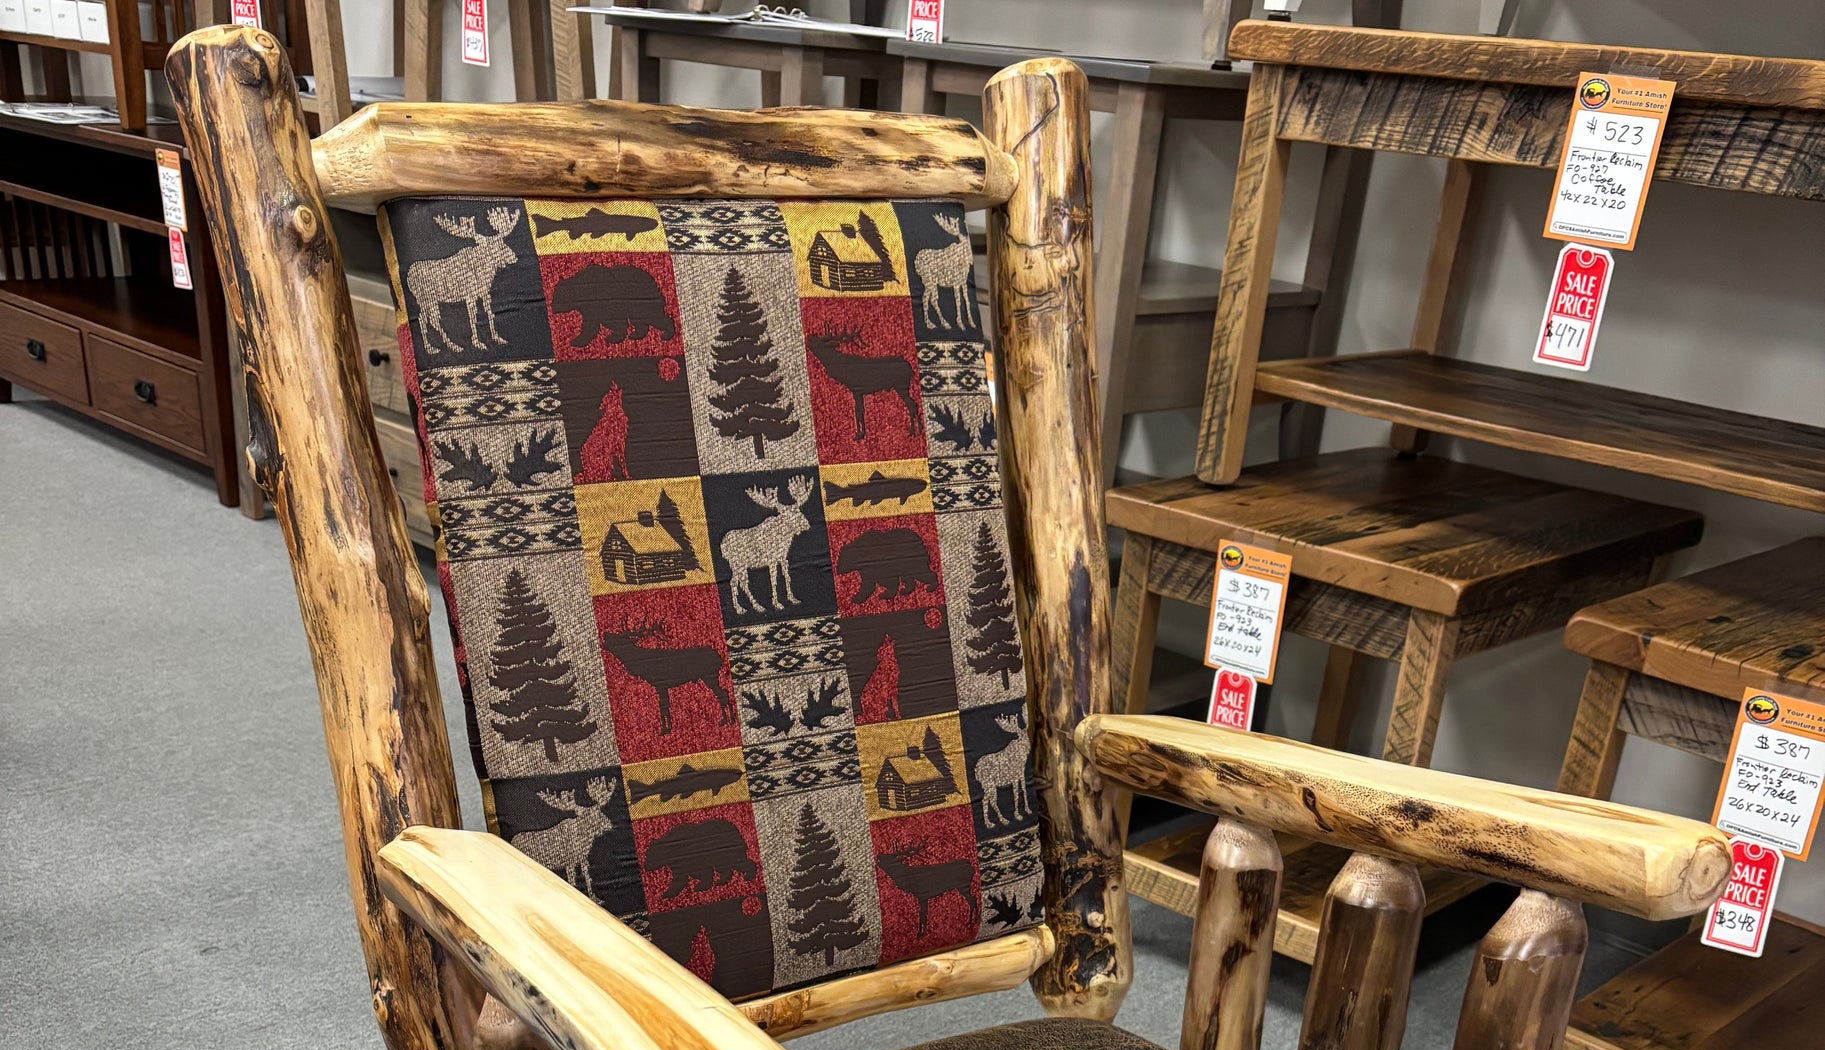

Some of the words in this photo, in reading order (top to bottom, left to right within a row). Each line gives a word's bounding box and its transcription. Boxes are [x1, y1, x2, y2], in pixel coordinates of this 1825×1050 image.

[236, 3, 255, 16] PRICE
[913, 1, 938, 18] PRICE
[1611, 98, 1644, 107] Furniture
[1645, 91, 1667, 99] Amish
[1564, 271, 1597, 296] SALE
[1556, 292, 1595, 318] PRICE
[1220, 688, 1245, 709] SALE
[1215, 705, 1245, 728] PRICE
[1787, 708, 1804, 717] Your
[1781, 717, 1816, 730] Furniture
[1737, 779, 1760, 794] End
[1732, 862, 1767, 887] SALE
[1724, 881, 1765, 907] PRICE
[1715, 908, 1755, 932] $348
